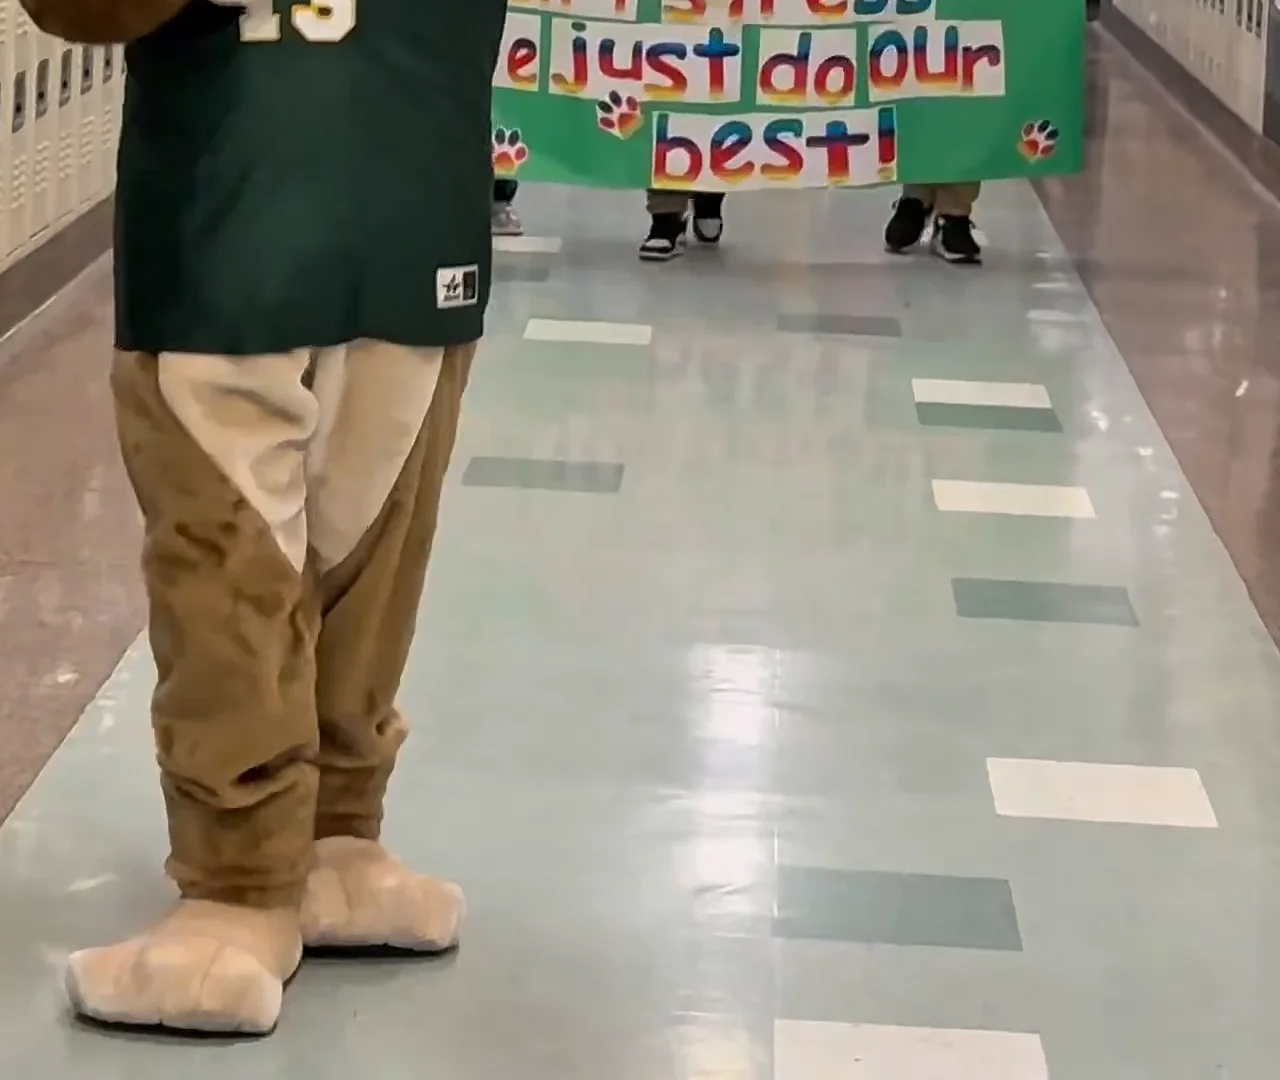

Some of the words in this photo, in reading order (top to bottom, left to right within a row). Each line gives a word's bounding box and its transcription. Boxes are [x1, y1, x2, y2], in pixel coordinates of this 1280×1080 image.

[551, 21, 740, 99] just
[760, 32, 855, 104] do
[654, 107, 896, 186] best!
